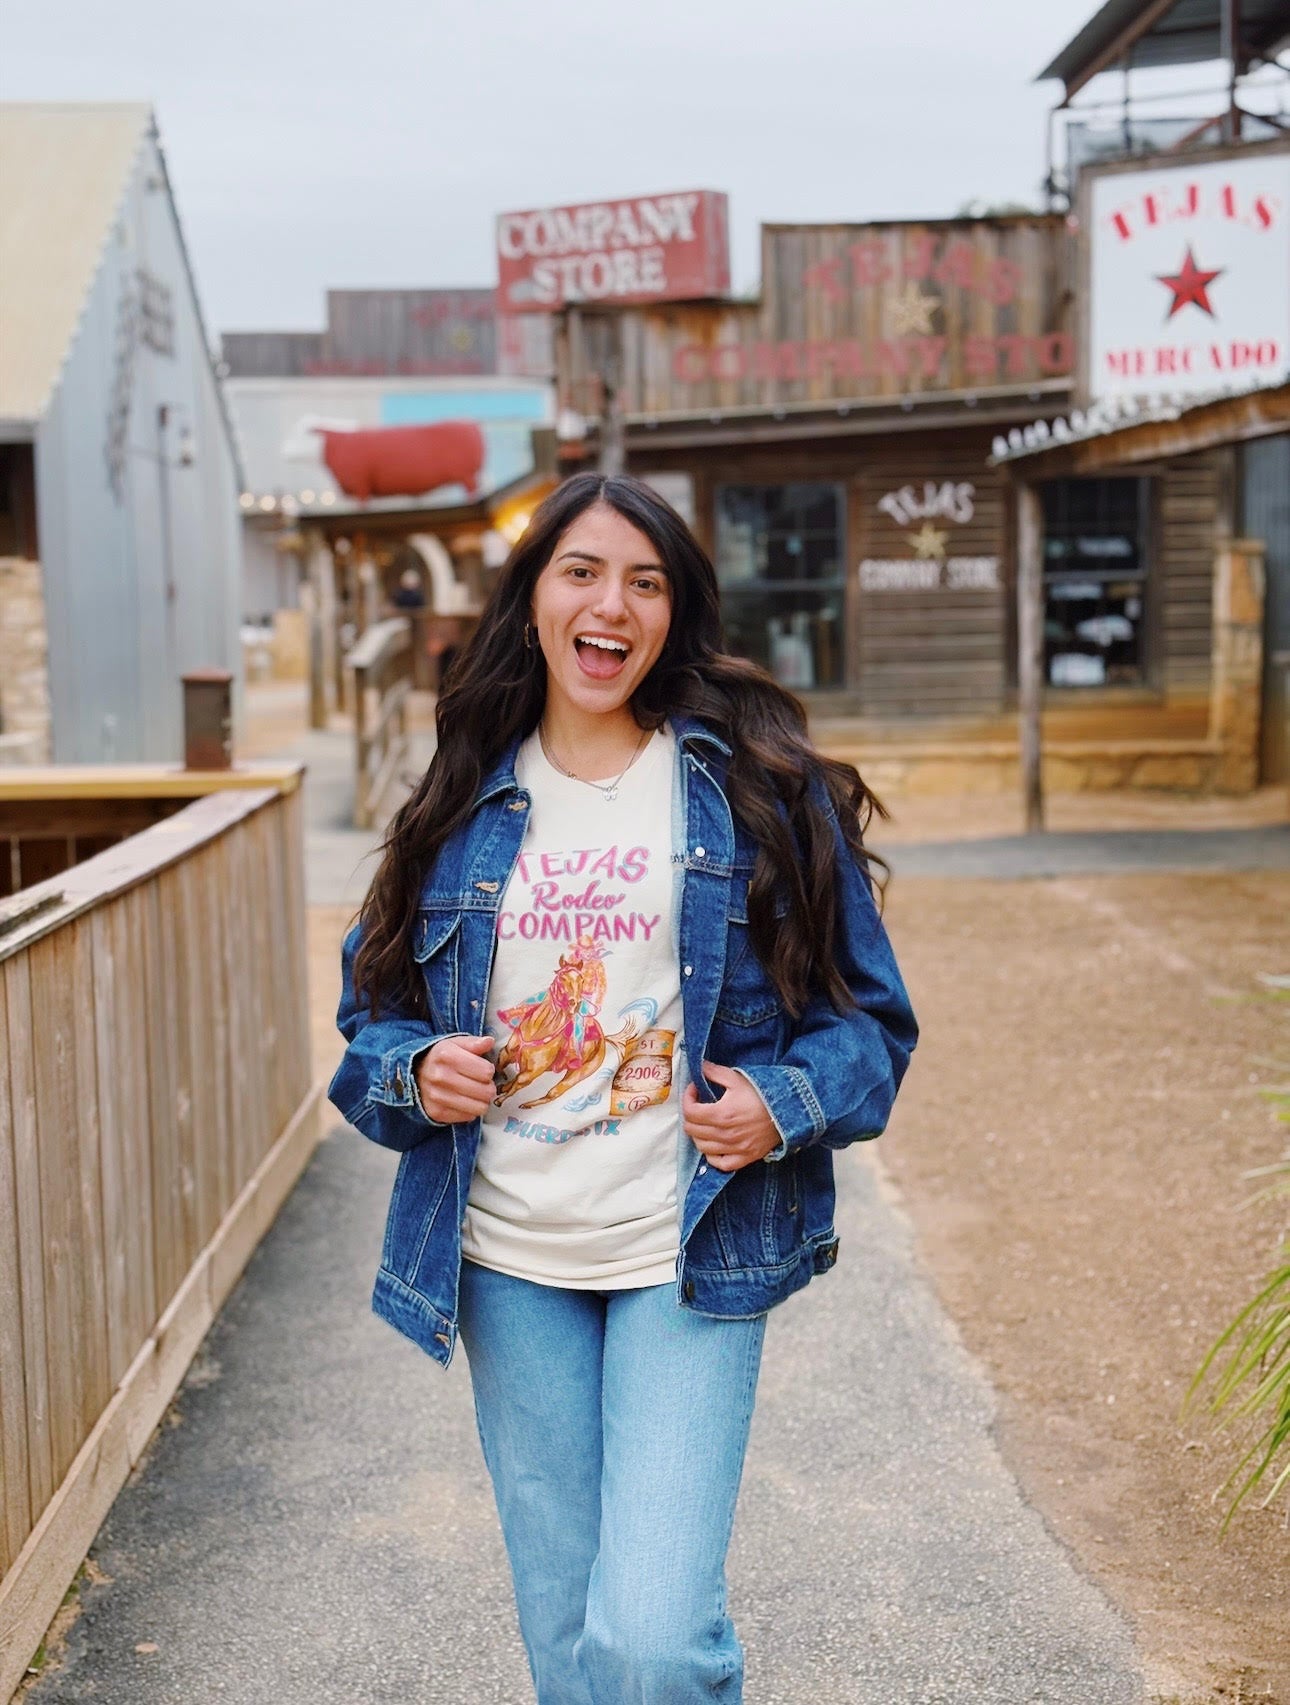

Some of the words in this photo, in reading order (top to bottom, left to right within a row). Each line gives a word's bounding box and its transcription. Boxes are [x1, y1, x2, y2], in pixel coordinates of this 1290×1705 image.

[500, 194, 698, 261] COMPANY
[1104, 182, 1281, 241] TEJAS
[533, 247, 668, 303] STORE
[803, 230, 1022, 306] TEJAS
[672, 336, 948, 384] COMPANY
[964, 332, 1076, 377] STO
[1105, 342, 1280, 379] MERCADO
[877, 480, 977, 526] TEJAS
[516, 845, 650, 884] TEJAS
[531, 880, 626, 912] Rodeo
[497, 911, 661, 941] COMPANY
[625, 1065, 661, 1081] 2006
